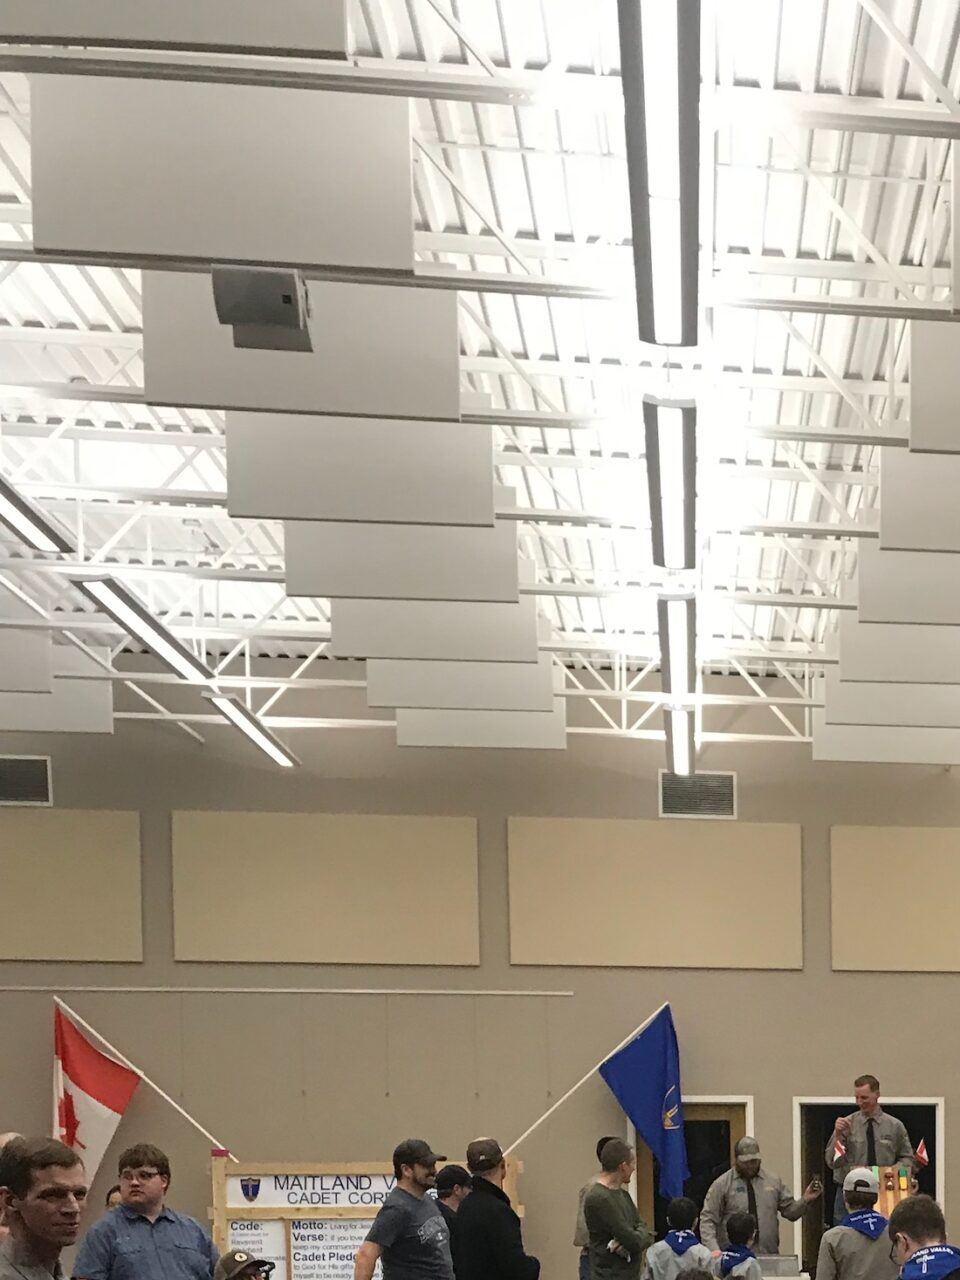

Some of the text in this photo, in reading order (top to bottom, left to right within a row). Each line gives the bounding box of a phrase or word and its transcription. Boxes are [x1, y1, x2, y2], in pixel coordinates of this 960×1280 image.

[274, 1175, 372, 1191] MAITLAND
[287, 1191, 341, 1205] CADET
[230, 1221, 263, 1231] Code:
[292, 1221, 328, 1230] Motto:
[292, 1232, 328, 1241] Verse:
[293, 1252, 326, 1261] Cadet
